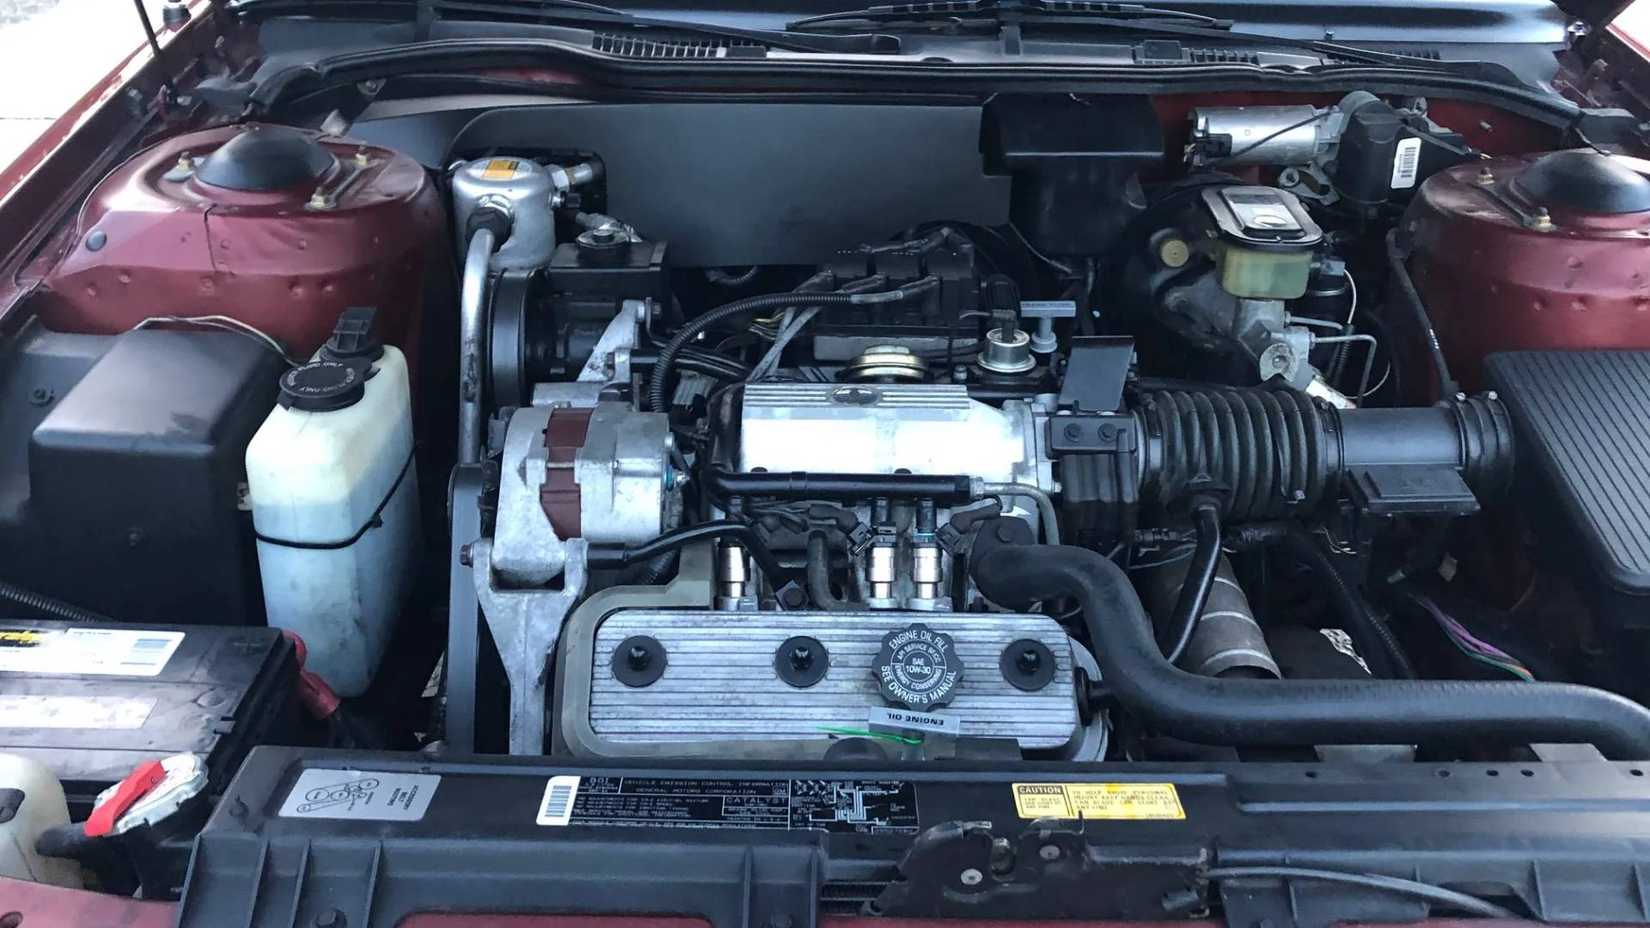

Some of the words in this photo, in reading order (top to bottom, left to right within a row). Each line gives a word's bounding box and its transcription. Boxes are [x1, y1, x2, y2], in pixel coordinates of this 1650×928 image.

[888, 630, 917, 649] ENGINE
[920, 630, 932, 640] OIL
[935, 637, 949, 652] FILL
[906, 665, 931, 674] 10W-30
[881, 665, 893, 683] SEE
[888, 682, 928, 703] OWNER'S
[929, 670, 957, 701] MANUAL
[905, 715, 944, 726] ENGINE
[1019, 786, 1062, 794] CAUTION
